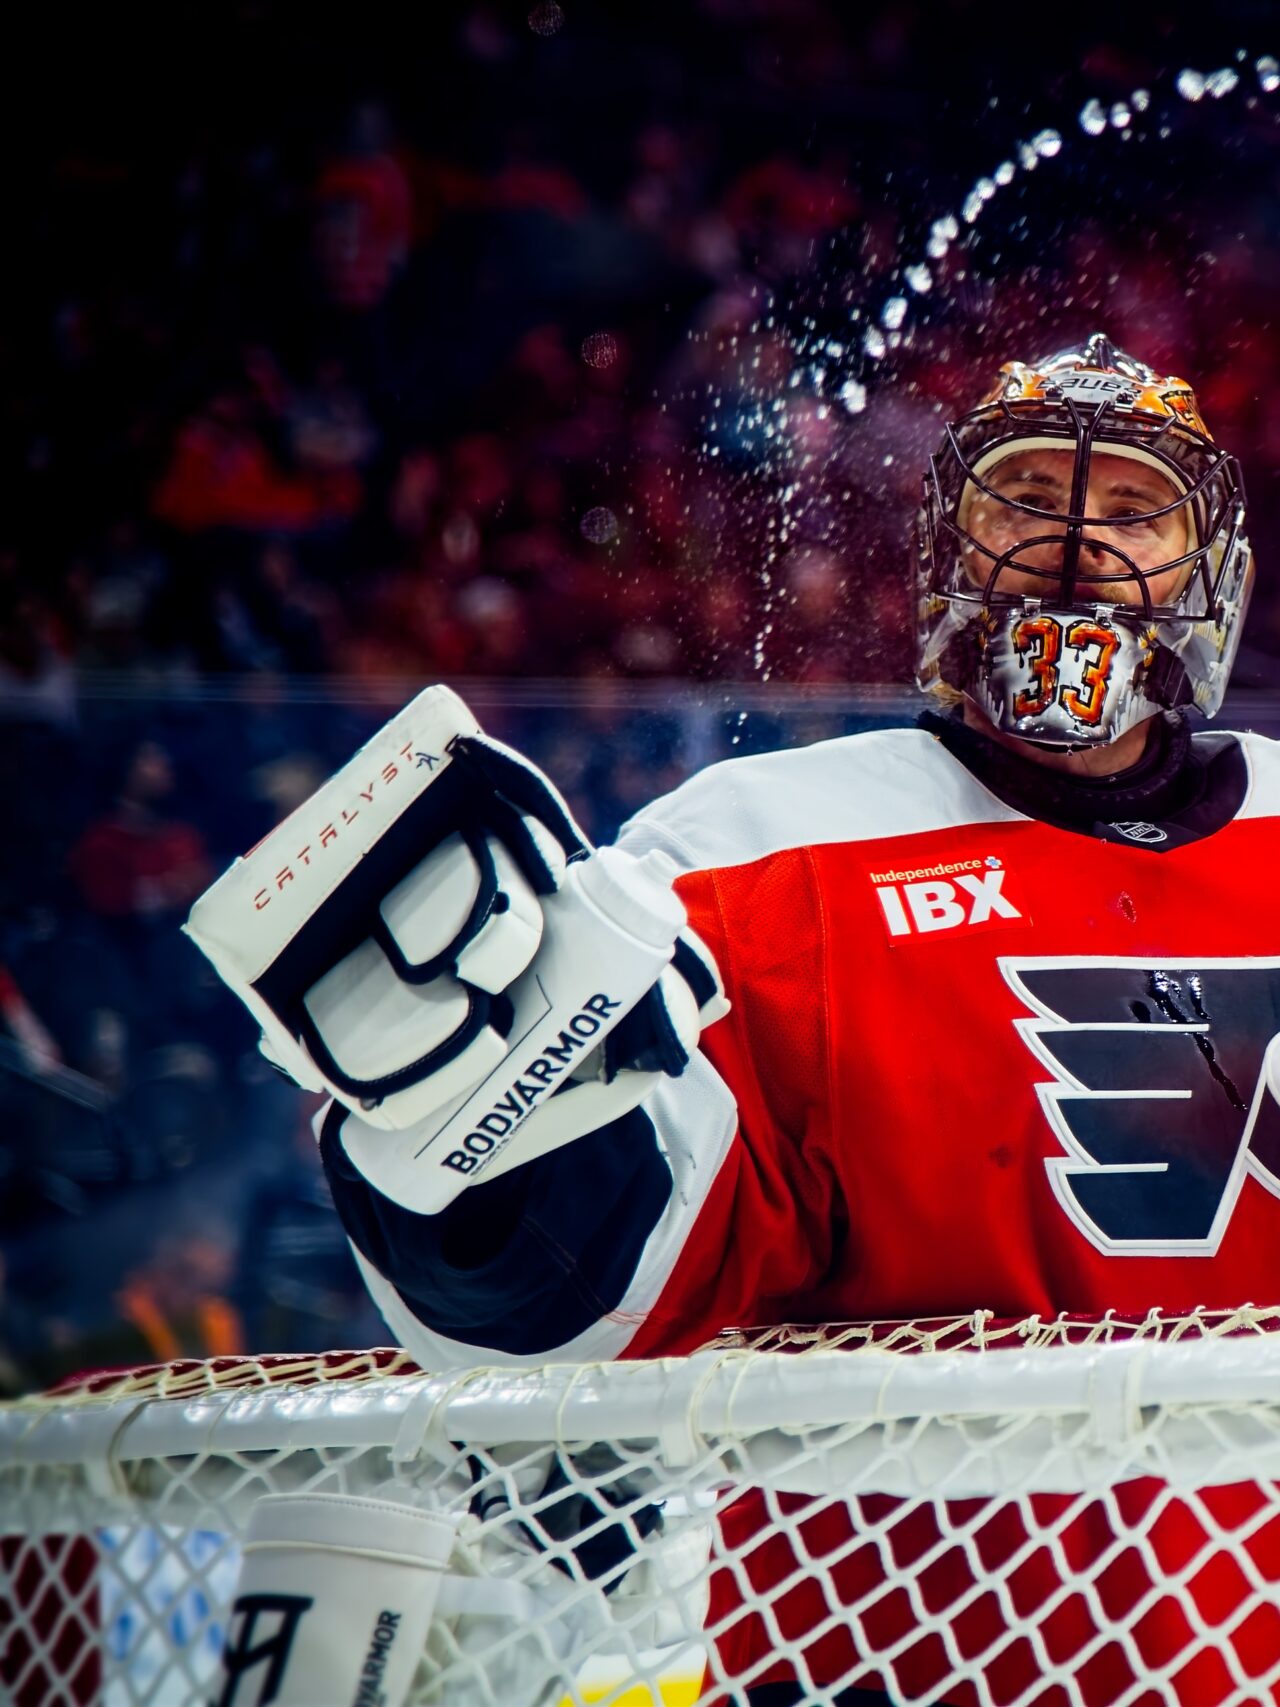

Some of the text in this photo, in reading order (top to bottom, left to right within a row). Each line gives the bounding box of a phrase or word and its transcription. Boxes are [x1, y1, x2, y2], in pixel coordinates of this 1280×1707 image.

[1013, 616, 1121, 727] 33
[253, 741, 415, 912] CATALYST
[870, 857, 982, 883] Independence
[875, 870, 1022, 936] IBX
[440, 993, 621, 1175] BODYARMOR
